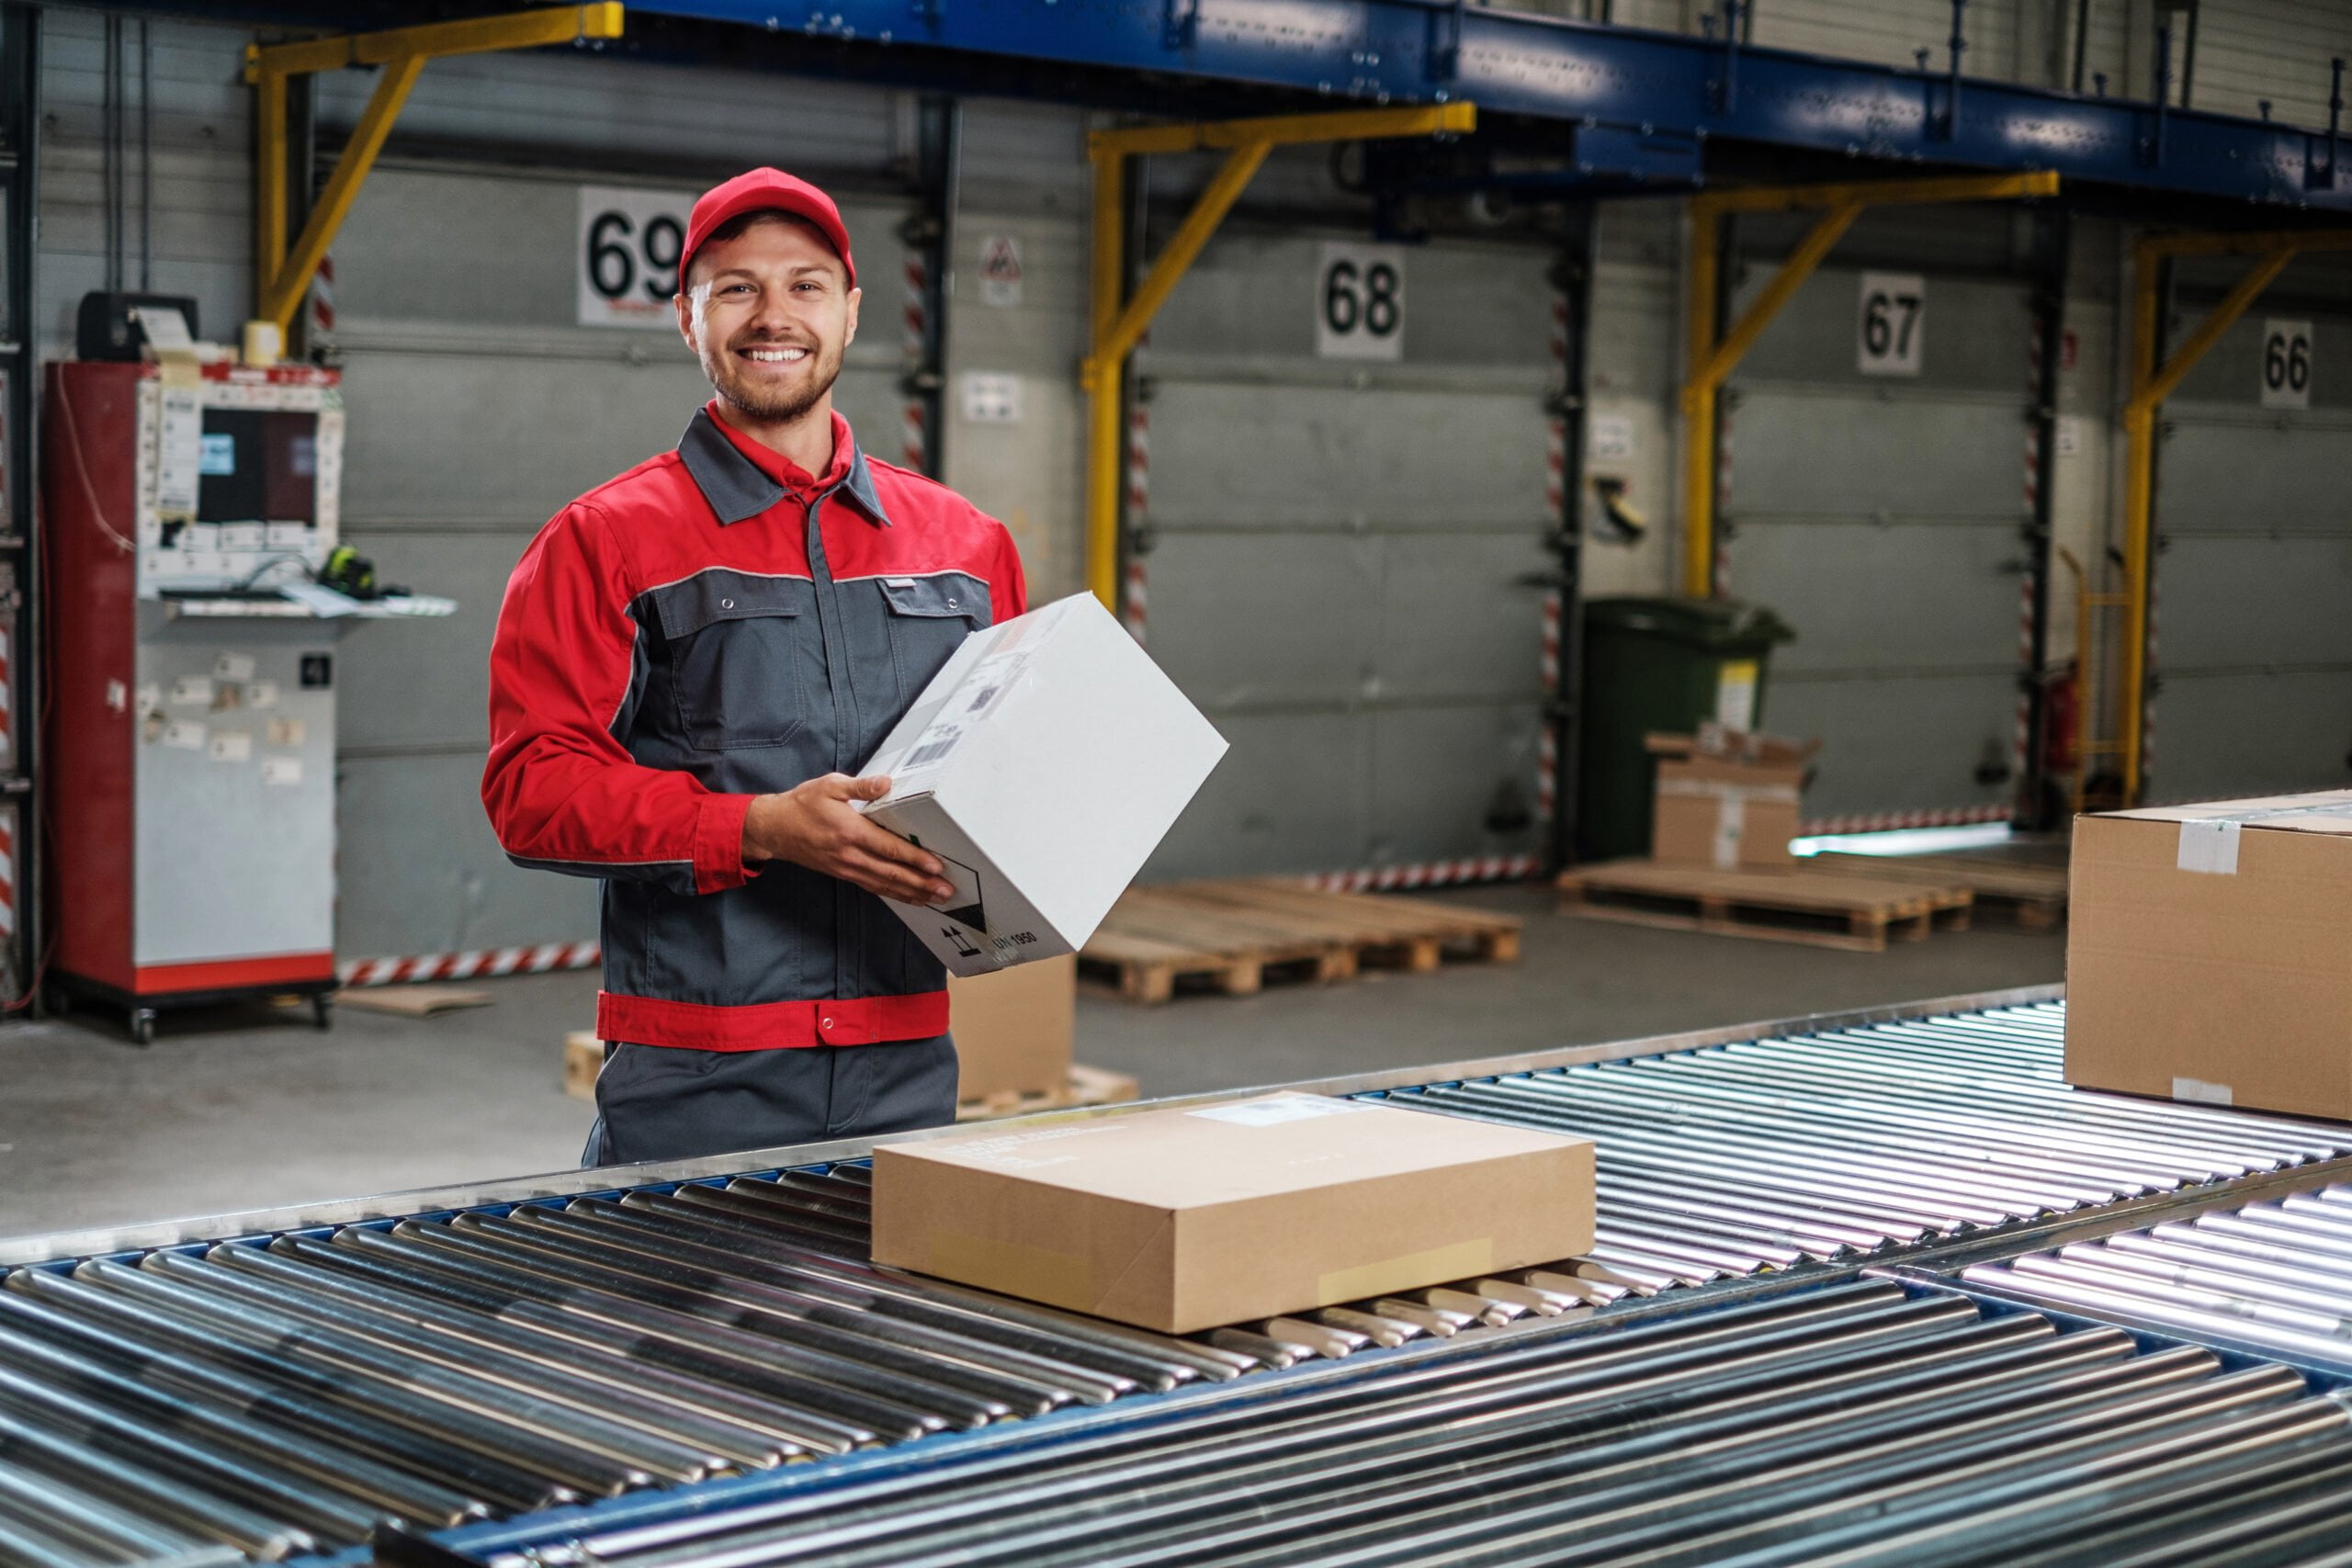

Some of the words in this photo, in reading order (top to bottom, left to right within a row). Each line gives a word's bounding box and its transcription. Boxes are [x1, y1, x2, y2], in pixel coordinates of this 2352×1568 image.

[588, 210, 684, 301] 69
[1327, 259, 1398, 336] 68
[1865, 293, 1922, 359] 67
[2266, 333, 2309, 392] 66
[992, 937, 1012, 949] UN
[1011, 931, 1037, 945] 1950
